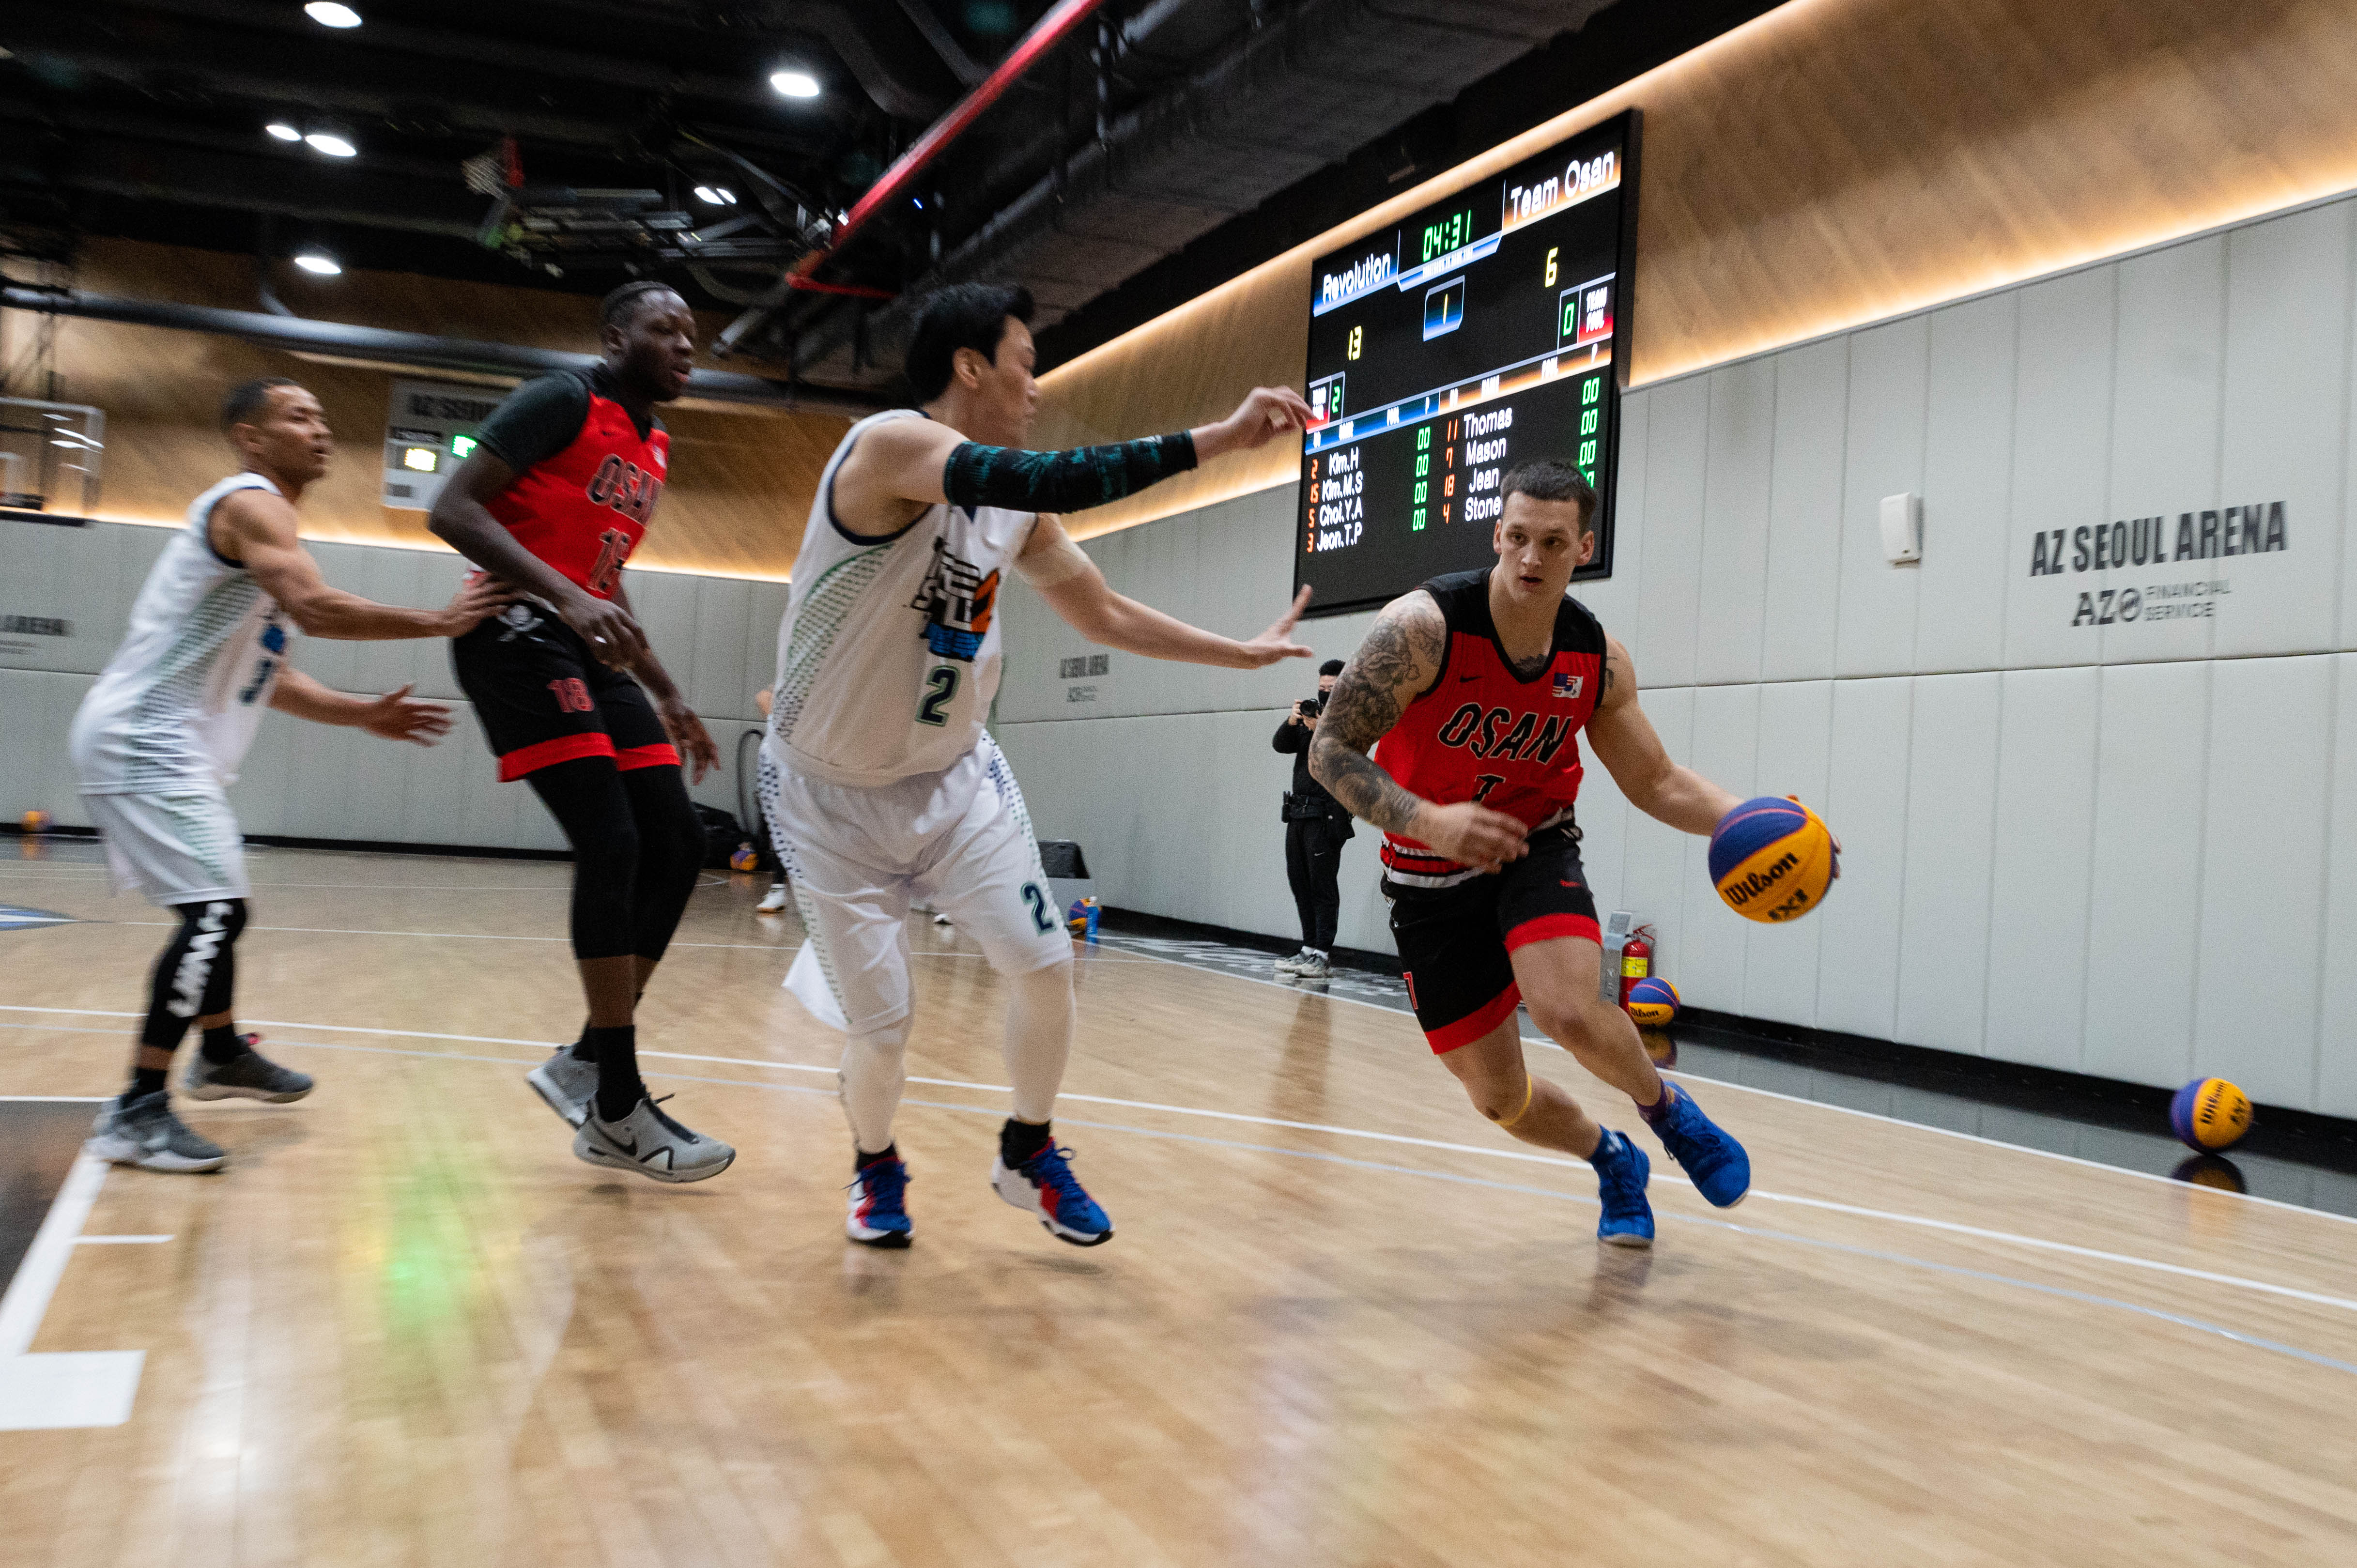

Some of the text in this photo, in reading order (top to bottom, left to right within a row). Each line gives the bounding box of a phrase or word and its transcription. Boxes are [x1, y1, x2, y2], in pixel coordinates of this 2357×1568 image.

[1510, 151, 1614, 222] Team Osan
[1423, 209, 1471, 262] 04:31
[1322, 253, 1391, 305] Revolution
[1545, 247, 1558, 288] 6
[1443, 293, 1448, 325] 1
[1563, 302, 1574, 336] 0
[1348, 325, 1362, 360] 13
[1332, 385, 1340, 413] 2
[1447, 376, 1600, 442] 11 Thomas 00
[1310, 426, 1431, 480] 2 Kim.H 00
[1446, 408, 1598, 469] 7 Mason 00
[1310, 453, 1429, 504] 15 Kim.M.S 00
[1444, 439, 1597, 497] 18 Jean 00
[1307, 507, 1426, 553] 3 Jeon.T.P 00
[1308, 480, 1428, 528] 5 Choi.Y.A 00
[1443, 495, 1501, 524] 4 Stone
[2029, 500, 2290, 577] AZ SEOUL ARENA
[2144, 601, 2216, 622] SERVICE
[2145, 580, 2231, 600] FINANCIAL
[915, 665, 960, 727] 2
[1437, 701, 1574, 766] OSAN
[1723, 852, 1801, 906] Wilson
[1020, 881, 1056, 936] 2
